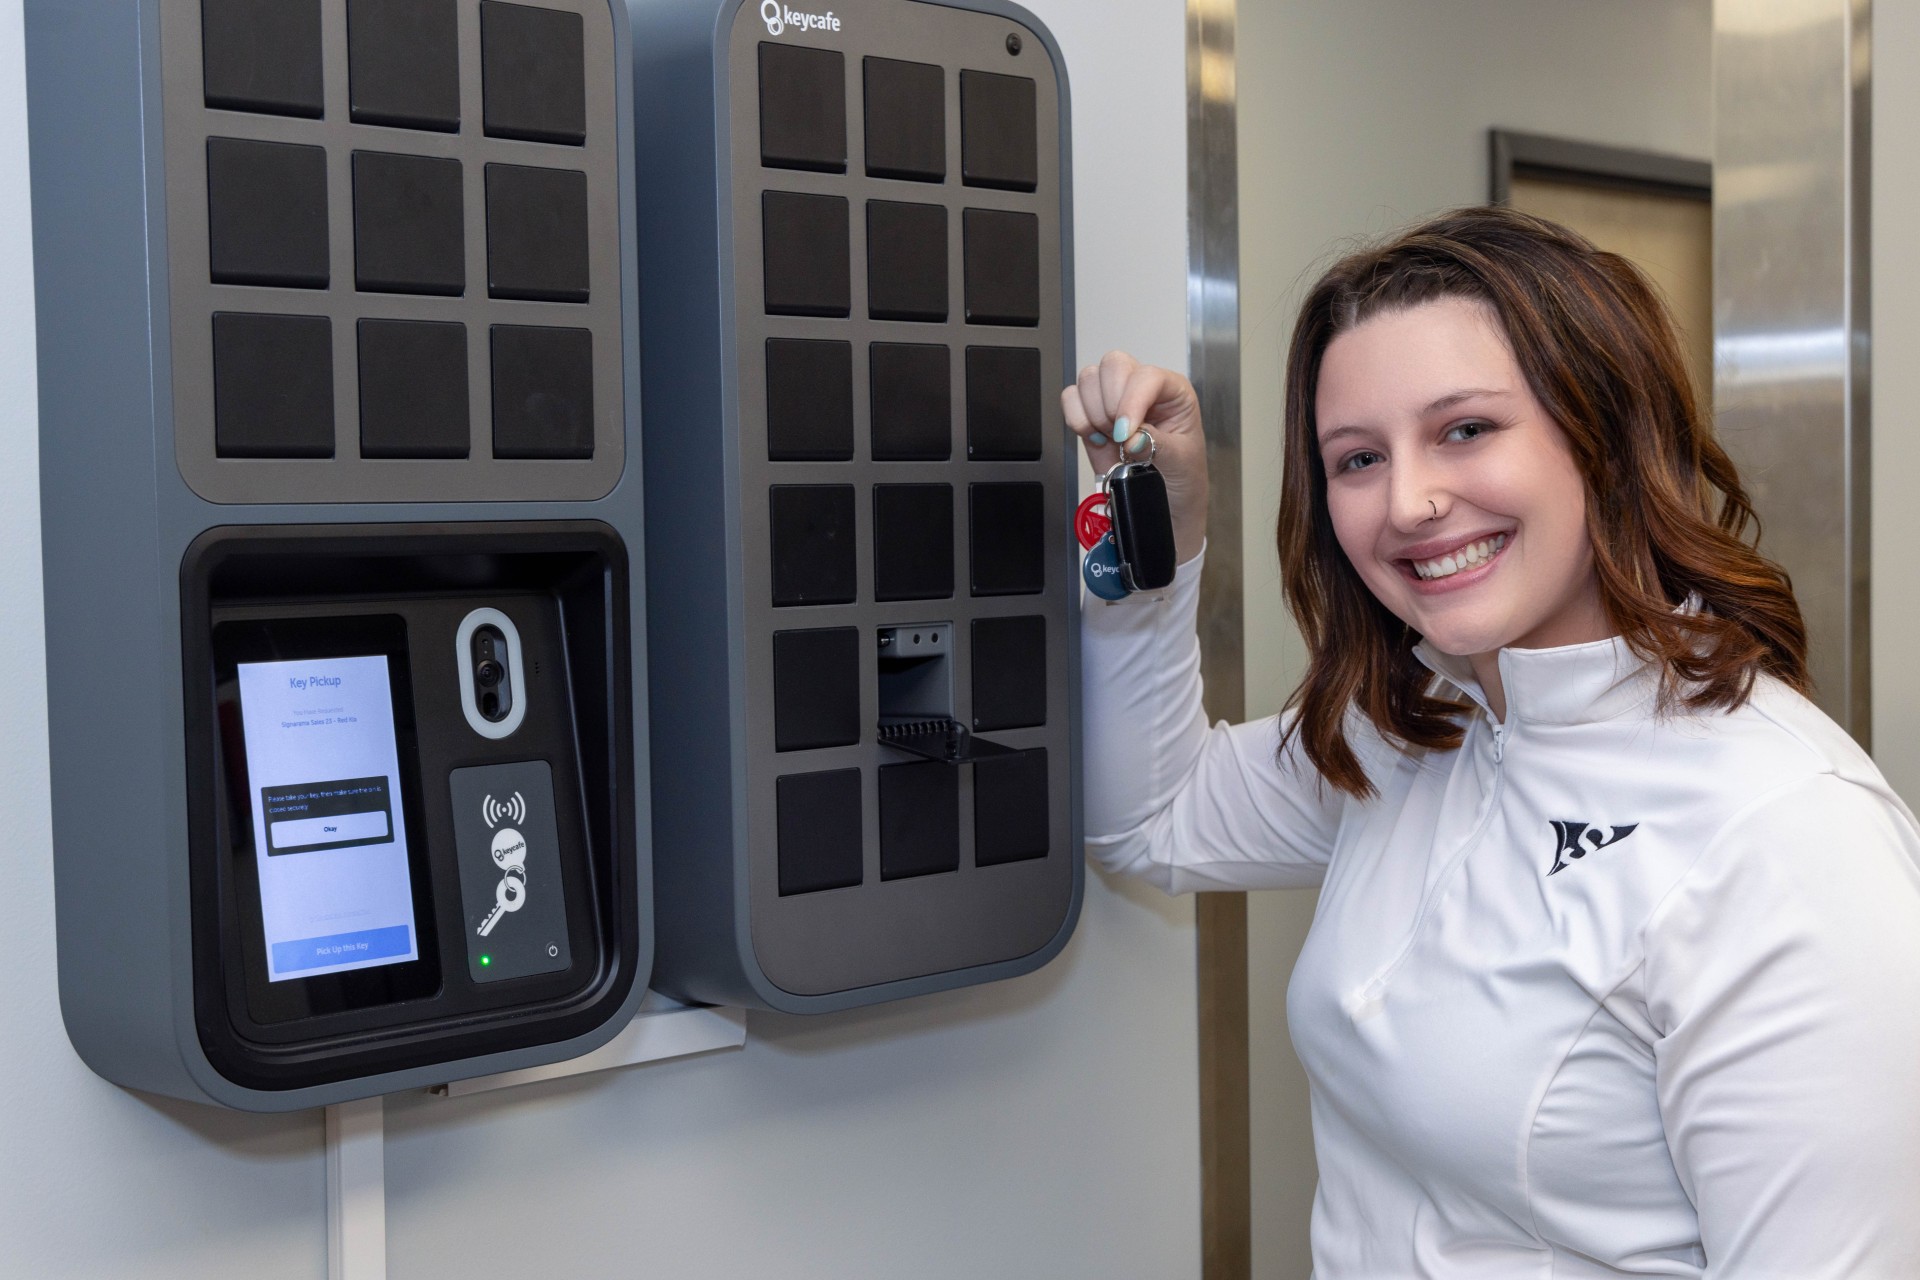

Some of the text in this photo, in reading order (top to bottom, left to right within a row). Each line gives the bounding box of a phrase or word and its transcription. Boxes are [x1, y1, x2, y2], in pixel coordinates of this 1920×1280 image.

[783, 4, 841, 32] keycafe
[1102, 564, 1120, 575] keyc
[290, 676, 341, 690] Key Pickup
[286, 793, 296, 801] take
[297, 793, 308, 801] your
[502, 841, 525, 855] keycafe
[316, 942, 369, 956] Pick Up this Key
